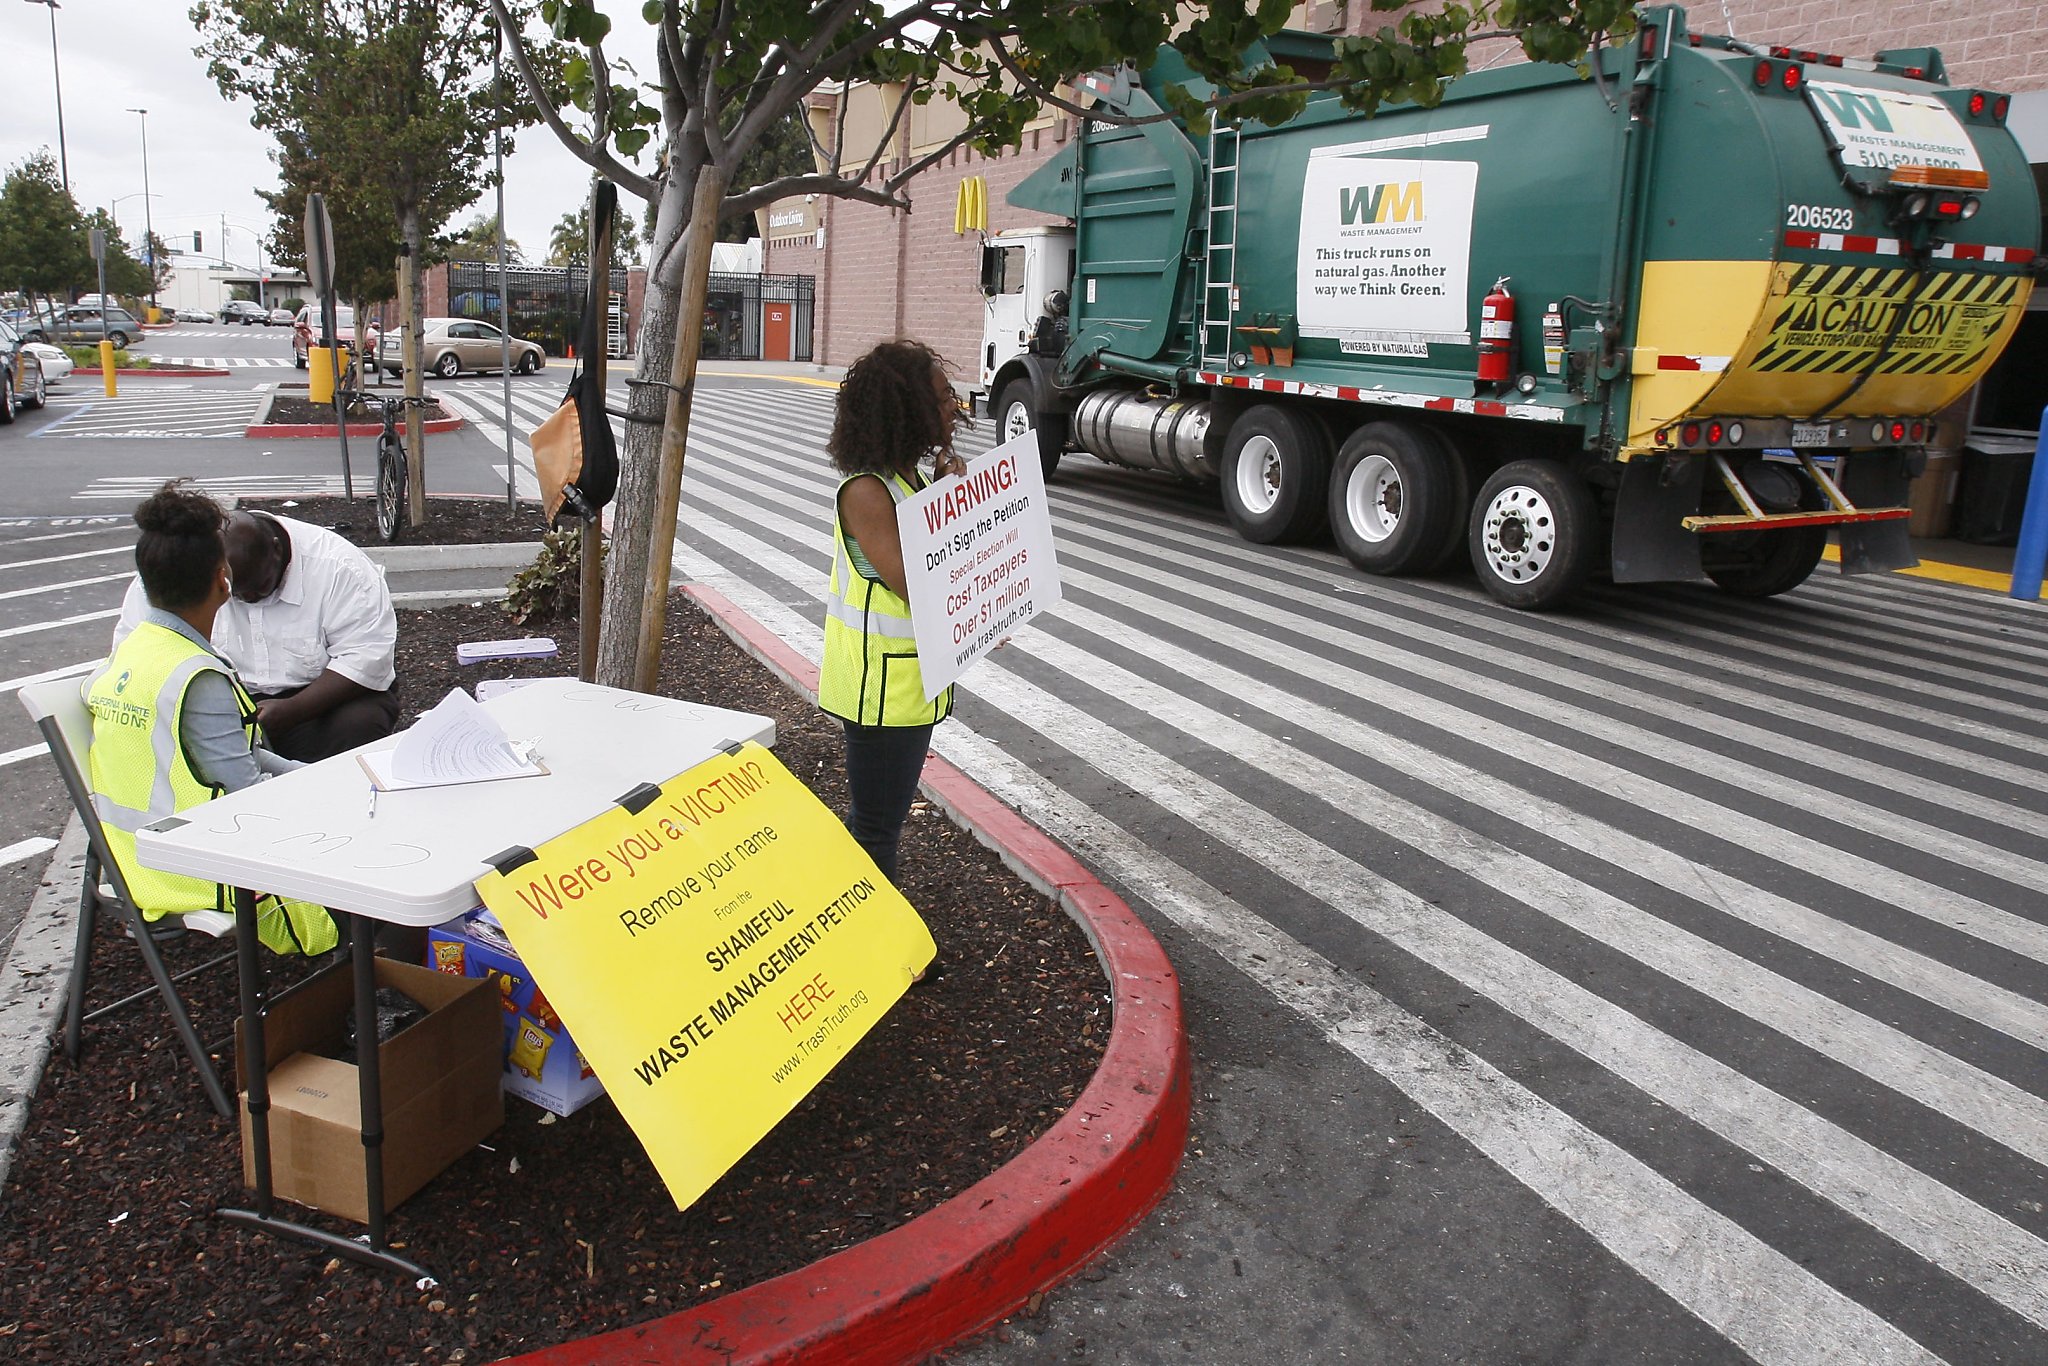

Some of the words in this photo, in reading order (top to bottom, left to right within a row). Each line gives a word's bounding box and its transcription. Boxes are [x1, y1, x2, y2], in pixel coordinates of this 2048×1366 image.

[1848, 133, 1888, 148] WASTE
[1889, 139, 1966, 157] MANAGEMENT
[770, 213, 788, 228] Outdoor
[789, 210, 804, 227] Living
[1340, 181, 1423, 225] WM
[1787, 204, 1853, 231] 206523
[1316, 248, 1341, 260] This
[1344, 246, 1377, 259] truck
[1380, 247, 1411, 259] runs
[1414, 247, 1431, 258] on
[1340, 229, 1365, 237] WASTE
[1366, 227, 1423, 236] MANAGEMENT
[1315, 265, 1359, 278] natural
[1362, 267, 1388, 281] gas.
[1390, 264, 1446, 277] Another
[1315, 285, 1338, 298] way
[1340, 285, 1357, 295] we
[1359, 282, 1396, 295] Think
[1400, 282, 1446, 296] Green.
[1783, 333, 1820, 346] VEHICLE
[1819, 334, 1845, 347] STOPS
[1845, 335, 1864, 347] AND
[1892, 336, 1941, 349] FREQUENTLY
[1821, 299, 1955, 335] CAUTON
[1341, 341, 1371, 351] POWERED
[1372, 343, 1381, 352] BY
[1382, 344, 1412, 354] NATURAL
[1413, 345, 1427, 355] GAS
[923, 456, 1018, 535] WARNING!
[926, 541, 953, 571] Don't
[954, 529, 976, 551] Sign
[977, 519, 992, 537] the
[993, 496, 1029, 526] Petition
[950, 556, 976, 584] Special
[976, 540, 1004, 565] Election
[1005, 527, 1019, 545] Will
[947, 583, 972, 616] Cost
[974, 549, 1027, 595] Taxpayers
[953, 613, 978, 644] Over
[981, 600, 992, 623] $1
[996, 577, 1030, 612] million
[956, 600, 1033, 666] www.trashtruth.org
[670, 761, 770, 826] VICTIM?
[607, 828, 664, 878] you
[658, 818, 684, 841] a
[515, 858, 611, 921] Were
[619, 878, 702, 937] Remove
[698, 852, 737, 890] your
[734, 825, 778, 861] name
[713, 900, 739, 921] From
[736, 889, 752, 908] the
[705, 899, 794, 973] SHAMEFUL
[633, 1014, 714, 1086] WASTE
[709, 922, 822, 1026] MANAGEMENT
[816, 876, 876, 932] PETITION
[776, 973, 835, 1033] HERE
[772, 989, 869, 1084] www.TrashTruth.org
